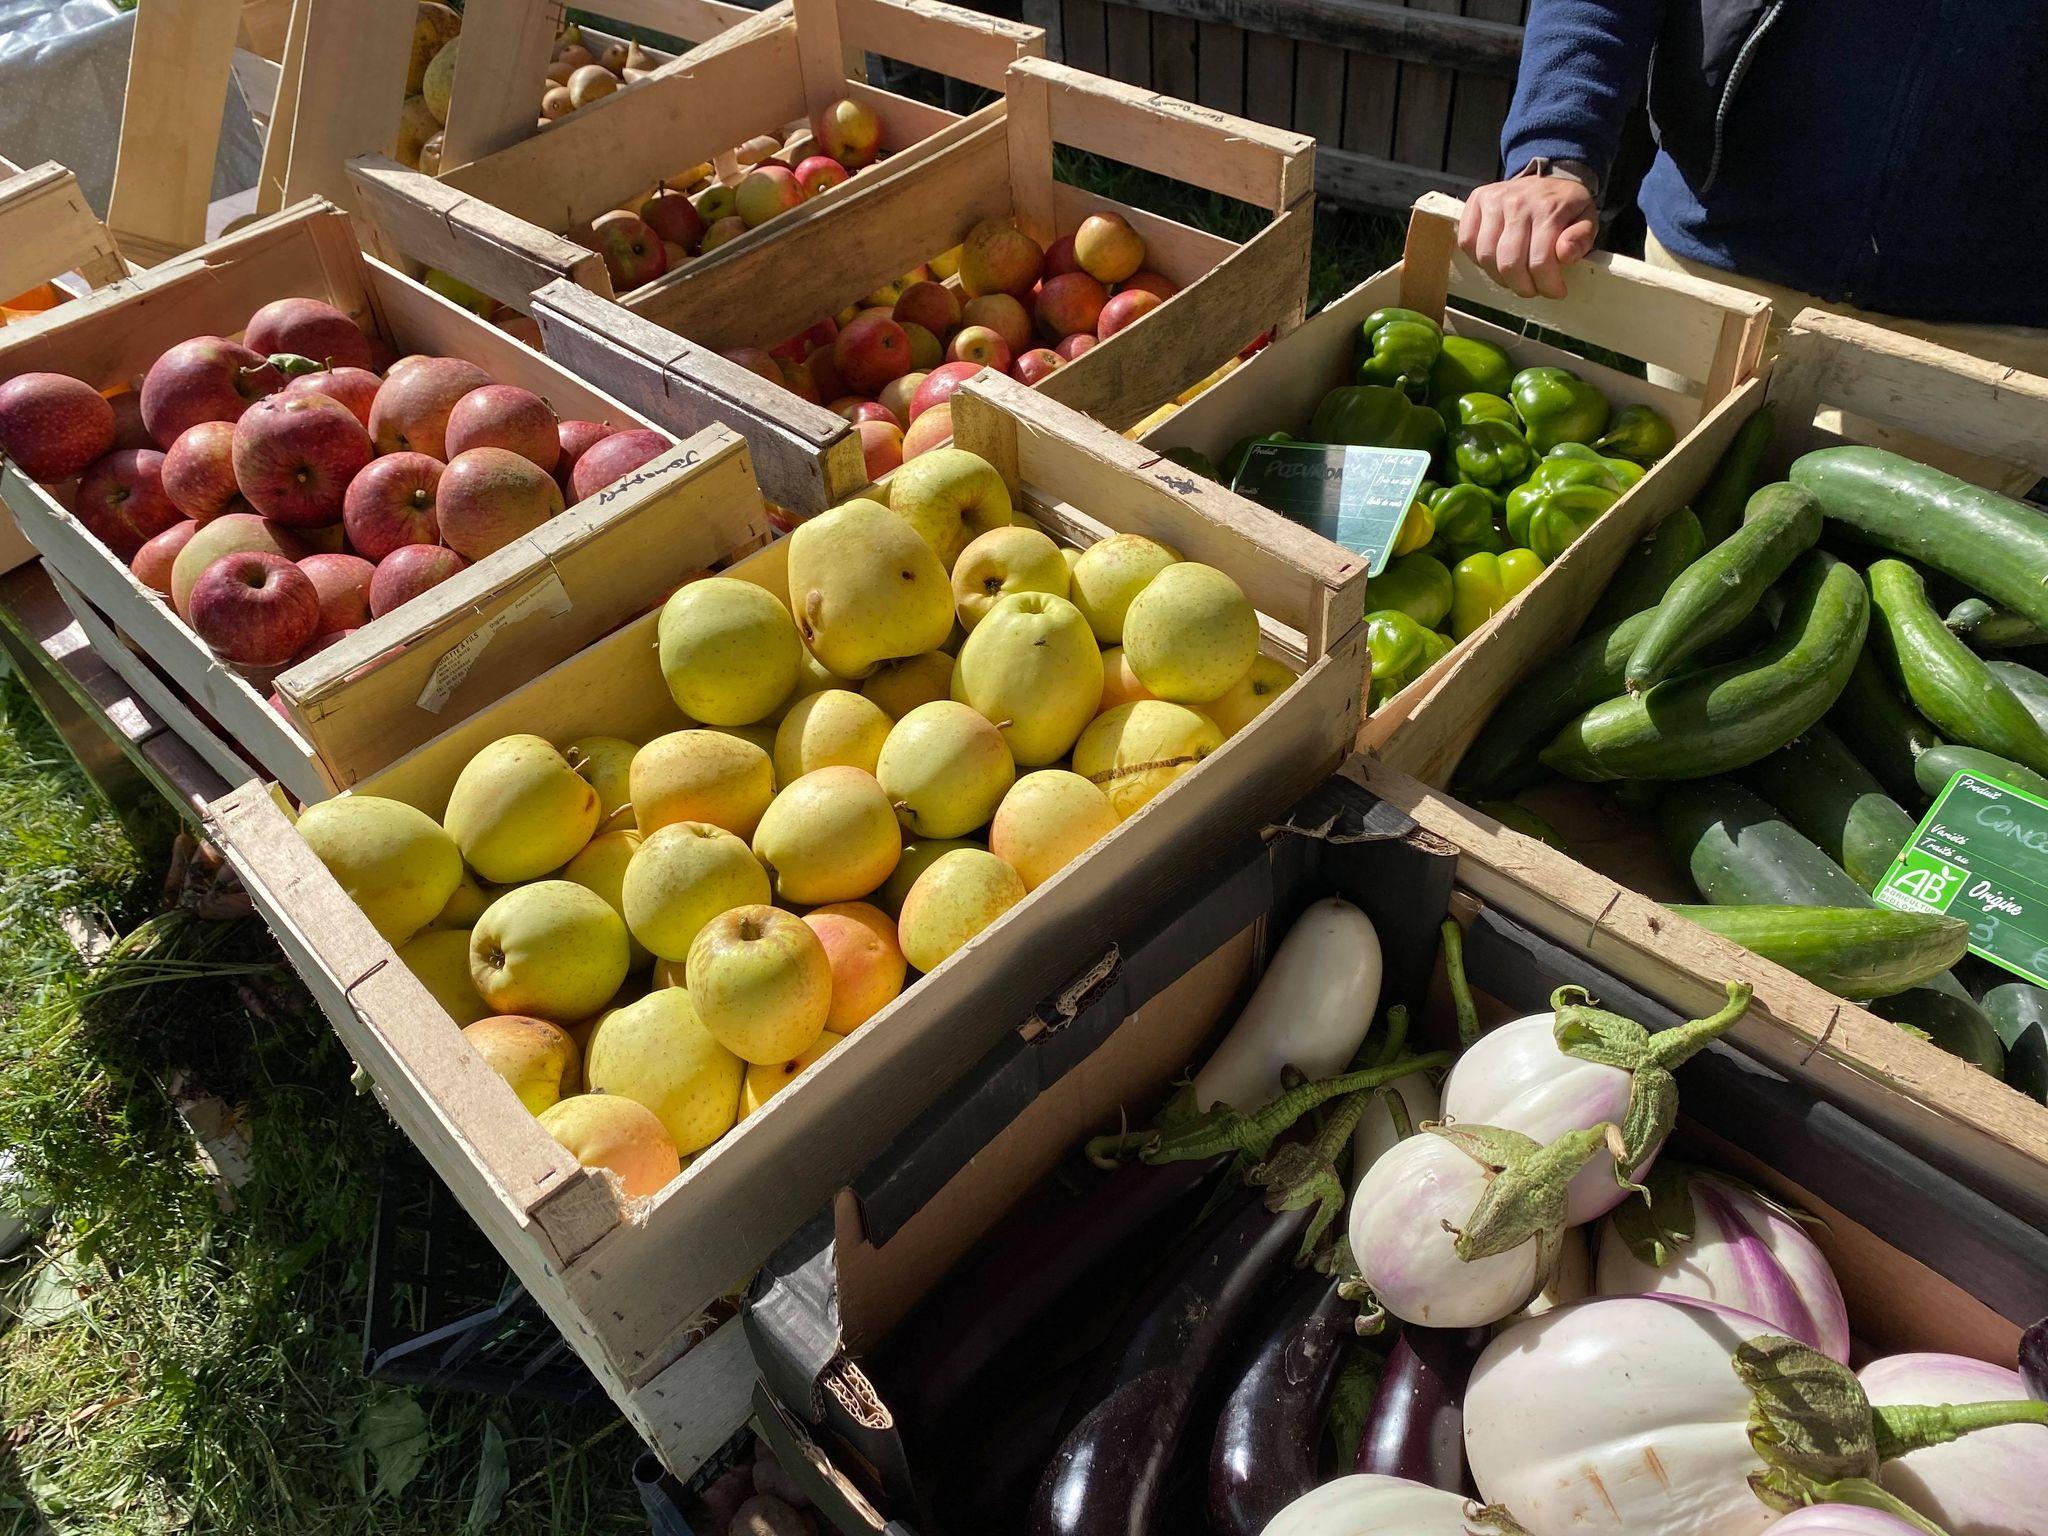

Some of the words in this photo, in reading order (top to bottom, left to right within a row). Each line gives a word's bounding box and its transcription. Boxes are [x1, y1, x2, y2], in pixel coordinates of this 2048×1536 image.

[466, 631, 480, 645] FILS
[1960, 778, 2002, 801] Produit
[1930, 823, 1971, 847] Variété
[1920, 837, 1954, 858] Traité
[1953, 852, 1970, 866] au
[1893, 868, 1949, 904] AB
[1967, 880, 2024, 917] Origine
[1884, 887, 1942, 914] AGRICULTUR
